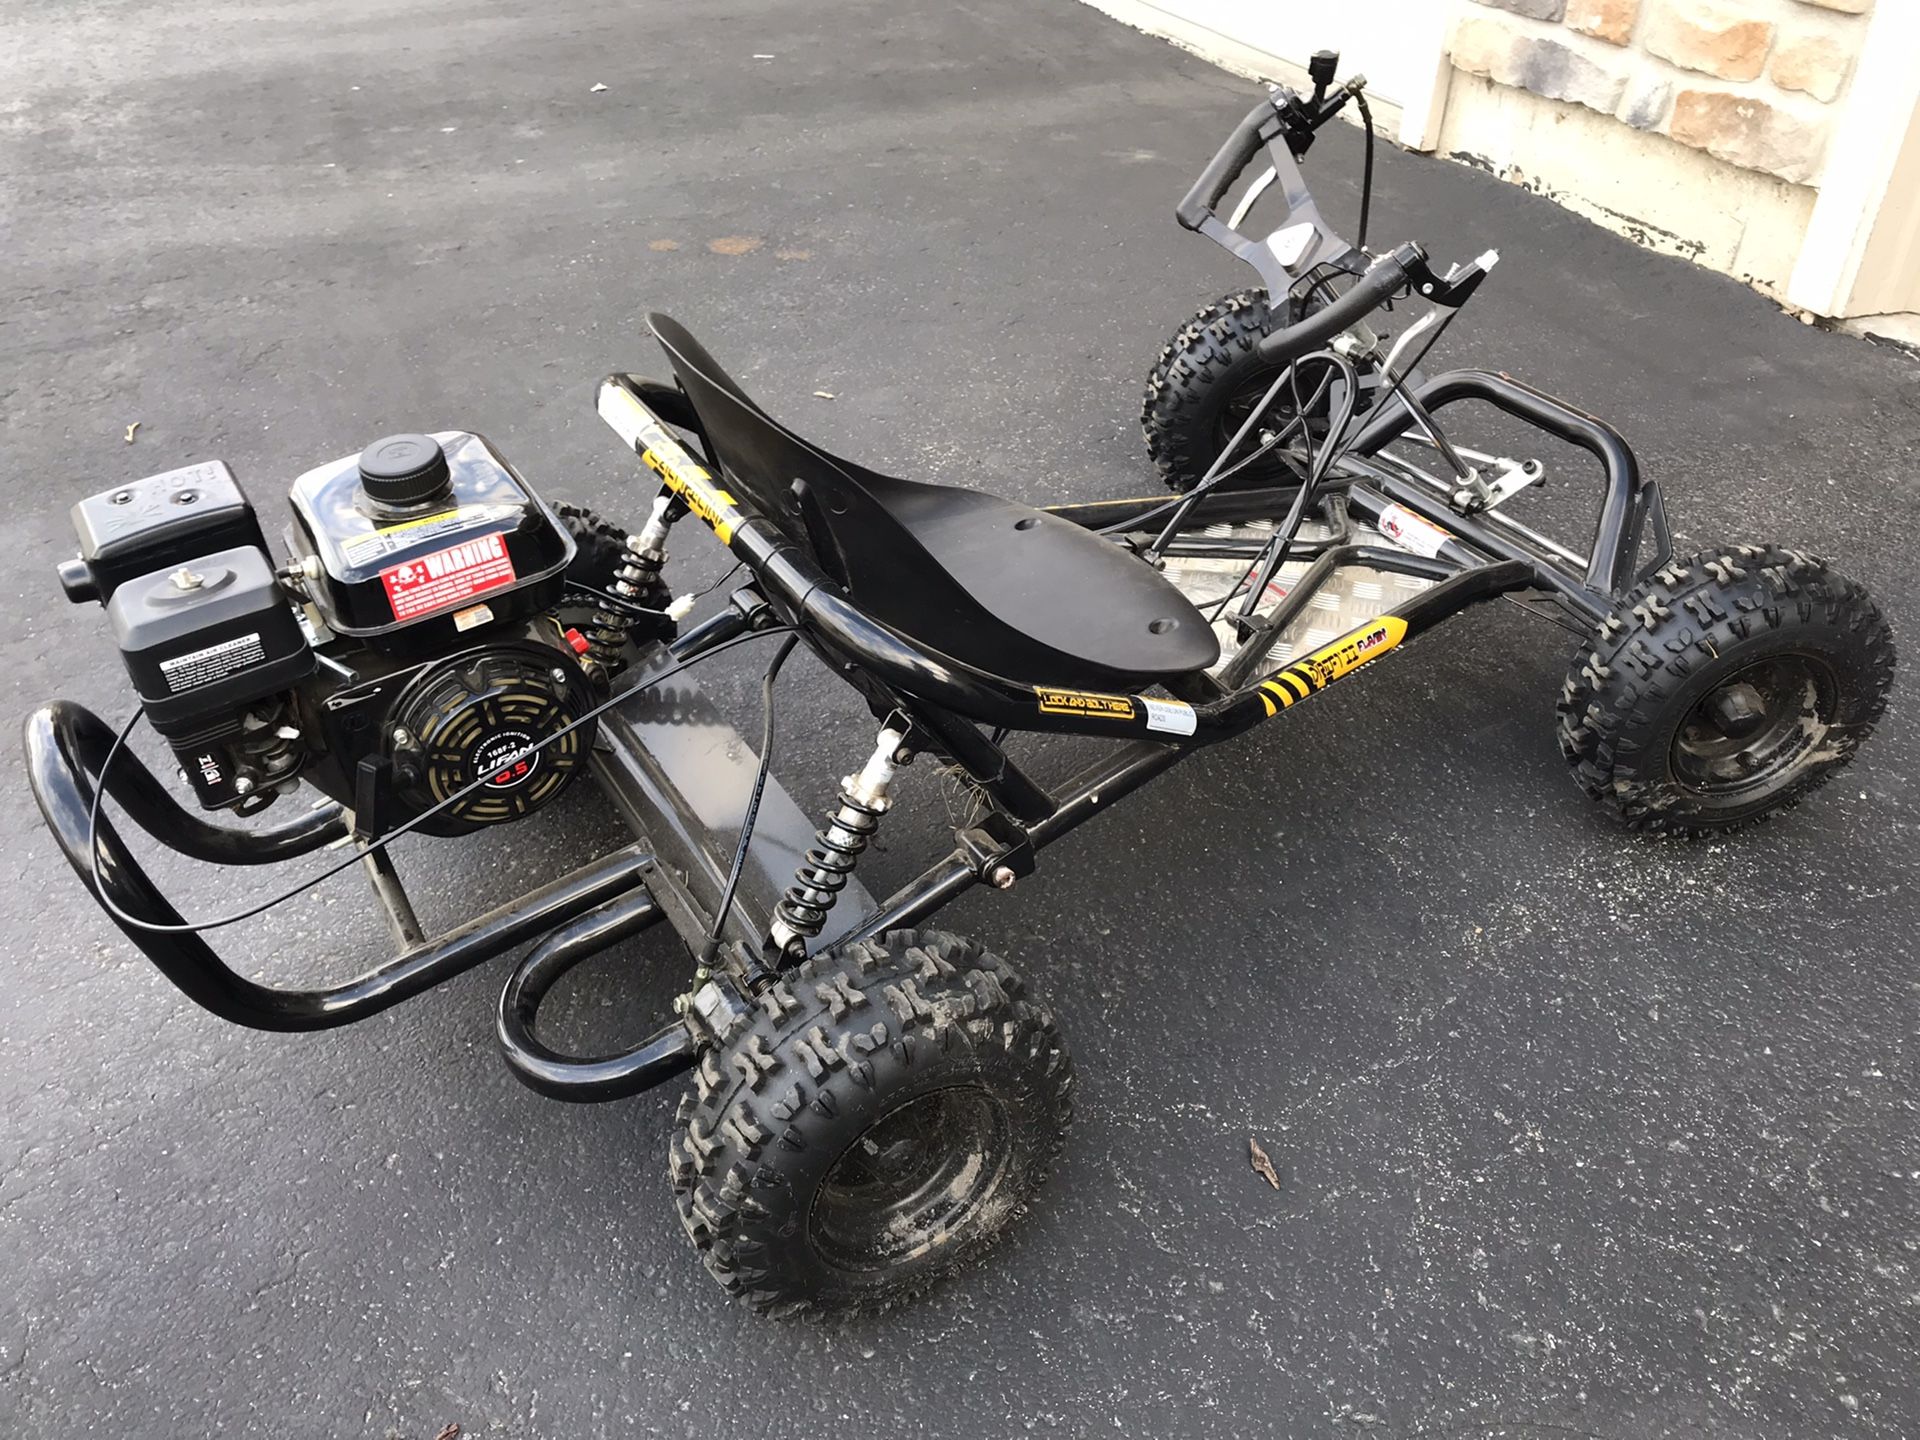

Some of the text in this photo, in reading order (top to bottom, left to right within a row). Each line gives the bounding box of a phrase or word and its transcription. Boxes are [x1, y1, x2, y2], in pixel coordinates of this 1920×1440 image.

[423, 535, 504, 580] WARNING
[170, 637, 251, 666] MAINTAIN AIR CLEANER
[1043, 694, 1069, 706] LOCK
[1069, 696, 1086, 708] AND
[1086, 698, 1108, 710] BOLT
[473, 731, 531, 764] ELECTRONIC IGNITION
[477, 742, 534, 776] LIFAN
[487, 741, 516, 759] 168F-2
